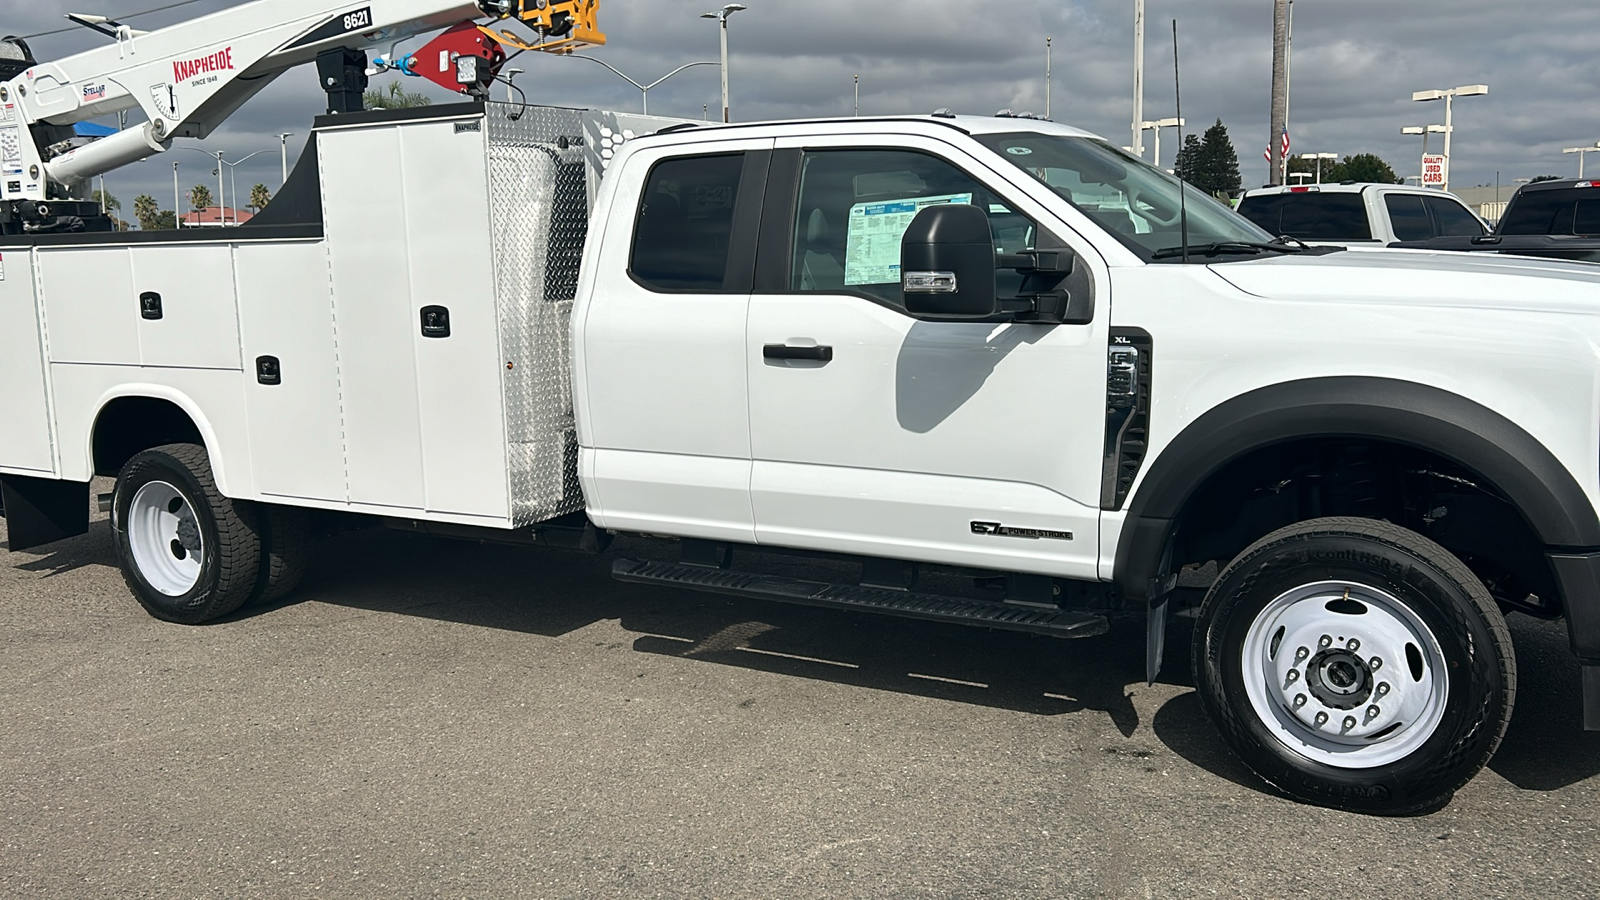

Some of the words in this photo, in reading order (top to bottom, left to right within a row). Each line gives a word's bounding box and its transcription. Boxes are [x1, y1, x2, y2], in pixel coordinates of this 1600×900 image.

[343, 10, 368, 30] 8621
[173, 46, 233, 84] KNAPHEIDE
[191, 78, 206, 87] SINCE
[1423, 173, 1442, 182] CARS
[1008, 528, 1037, 536] POWER
[1038, 530, 1071, 539] STROKE
